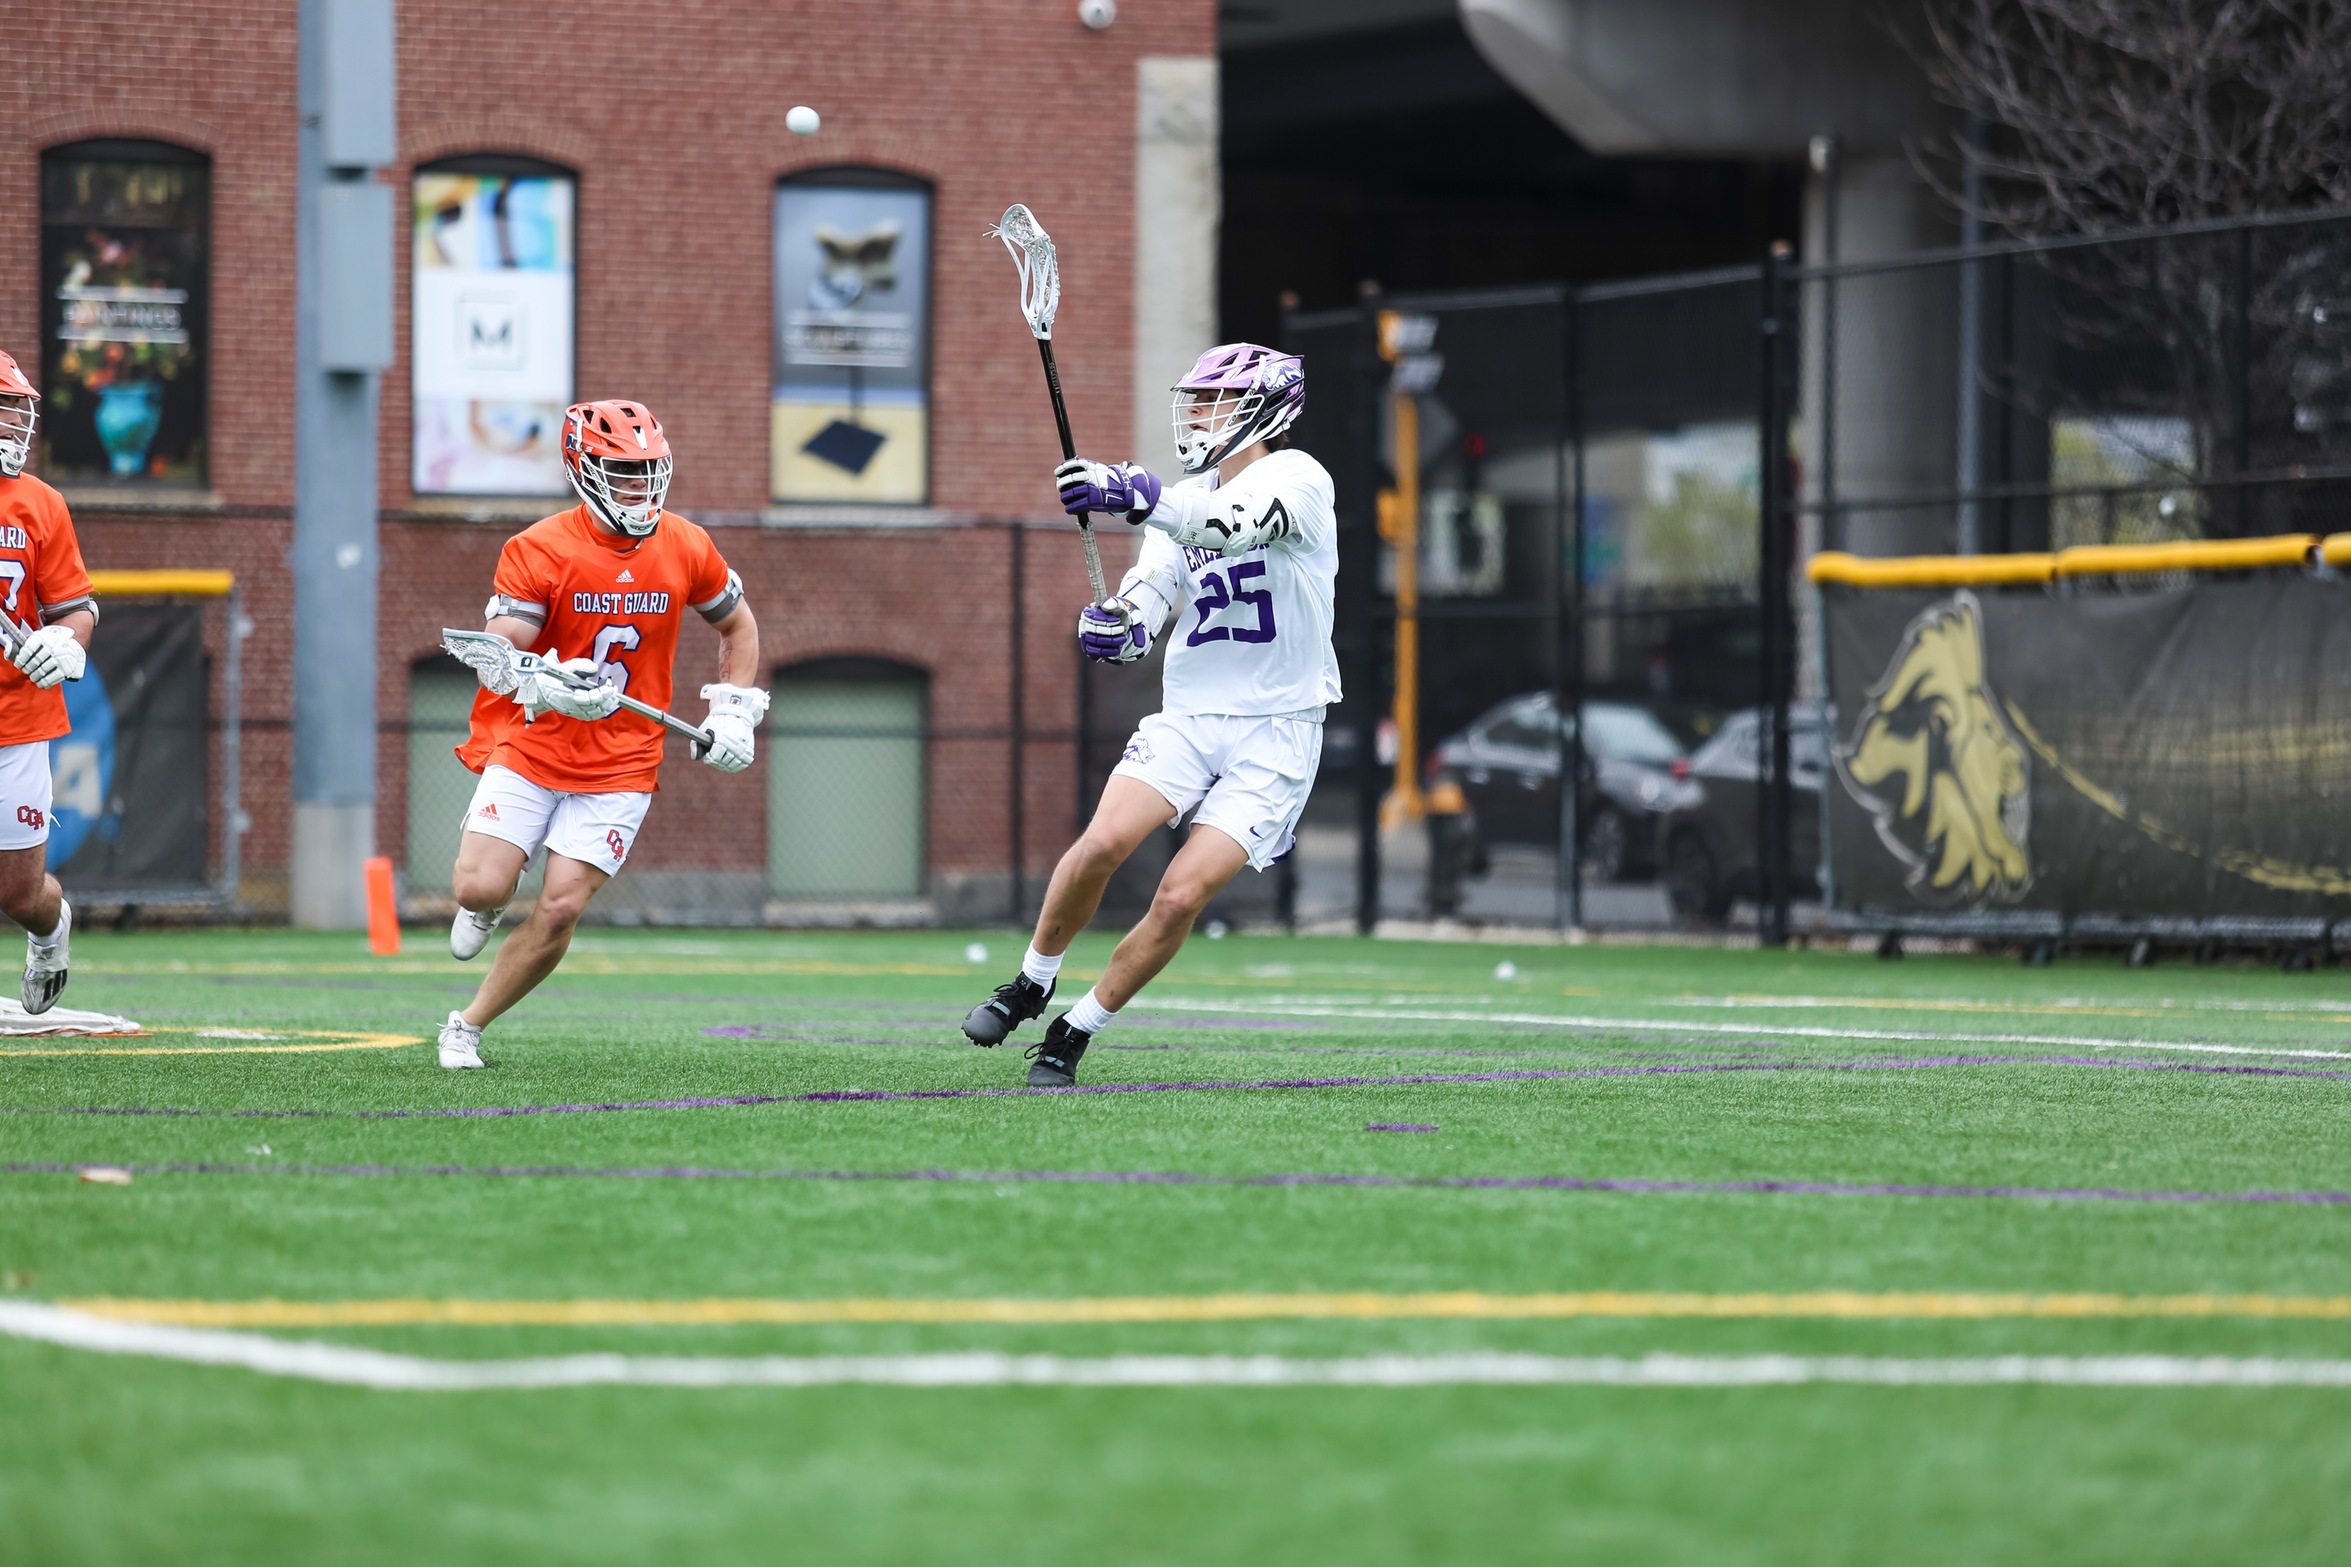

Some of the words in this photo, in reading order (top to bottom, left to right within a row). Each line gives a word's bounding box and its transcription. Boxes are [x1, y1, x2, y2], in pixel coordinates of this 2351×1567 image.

[573, 591, 622, 615] COAST
[623, 591, 670, 615] GUARD
[1186, 560, 1277, 647] 25
[588, 623, 642, 719] 6
[477, 811, 500, 821] adidas
